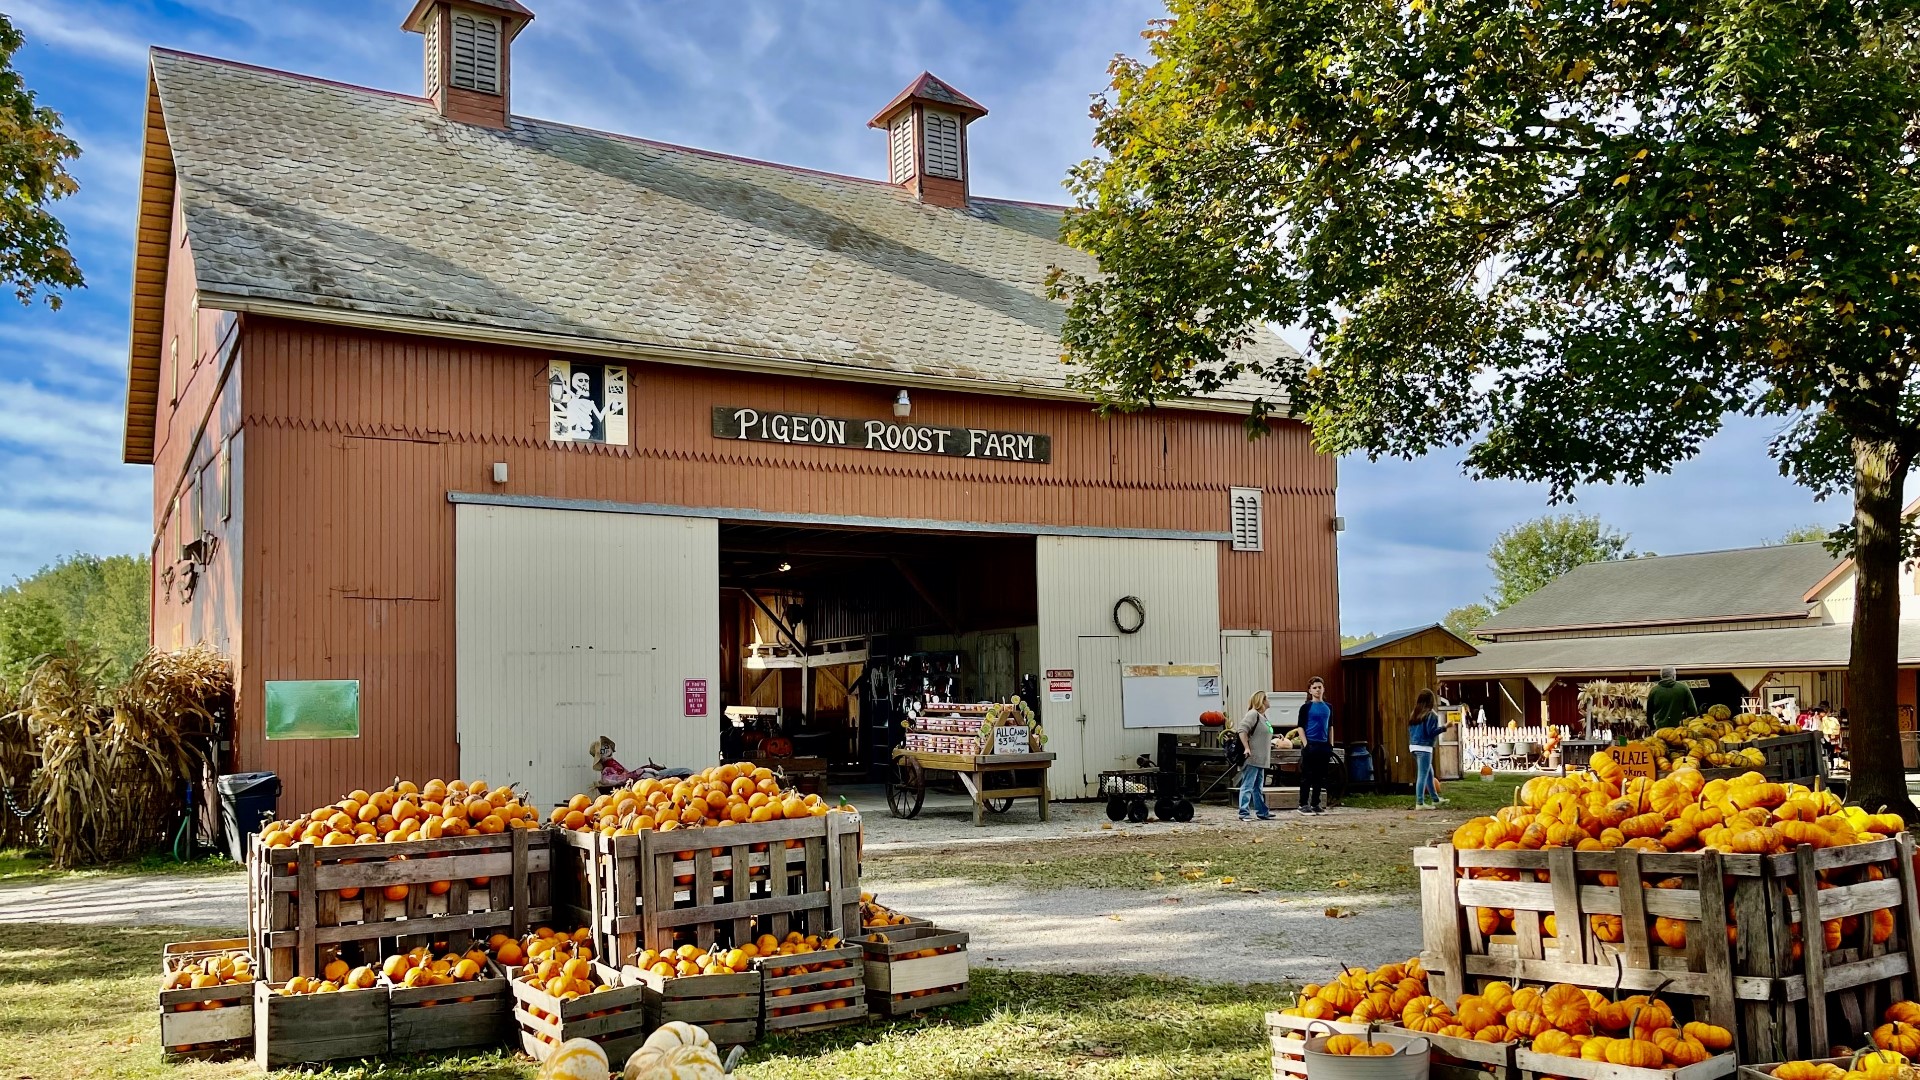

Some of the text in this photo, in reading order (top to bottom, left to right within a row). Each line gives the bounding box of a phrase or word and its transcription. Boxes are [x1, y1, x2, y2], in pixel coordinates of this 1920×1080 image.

[733, 408, 1035, 461] PIGEON ROOST FARM
[1612, 750, 1649, 766] BLAZE
